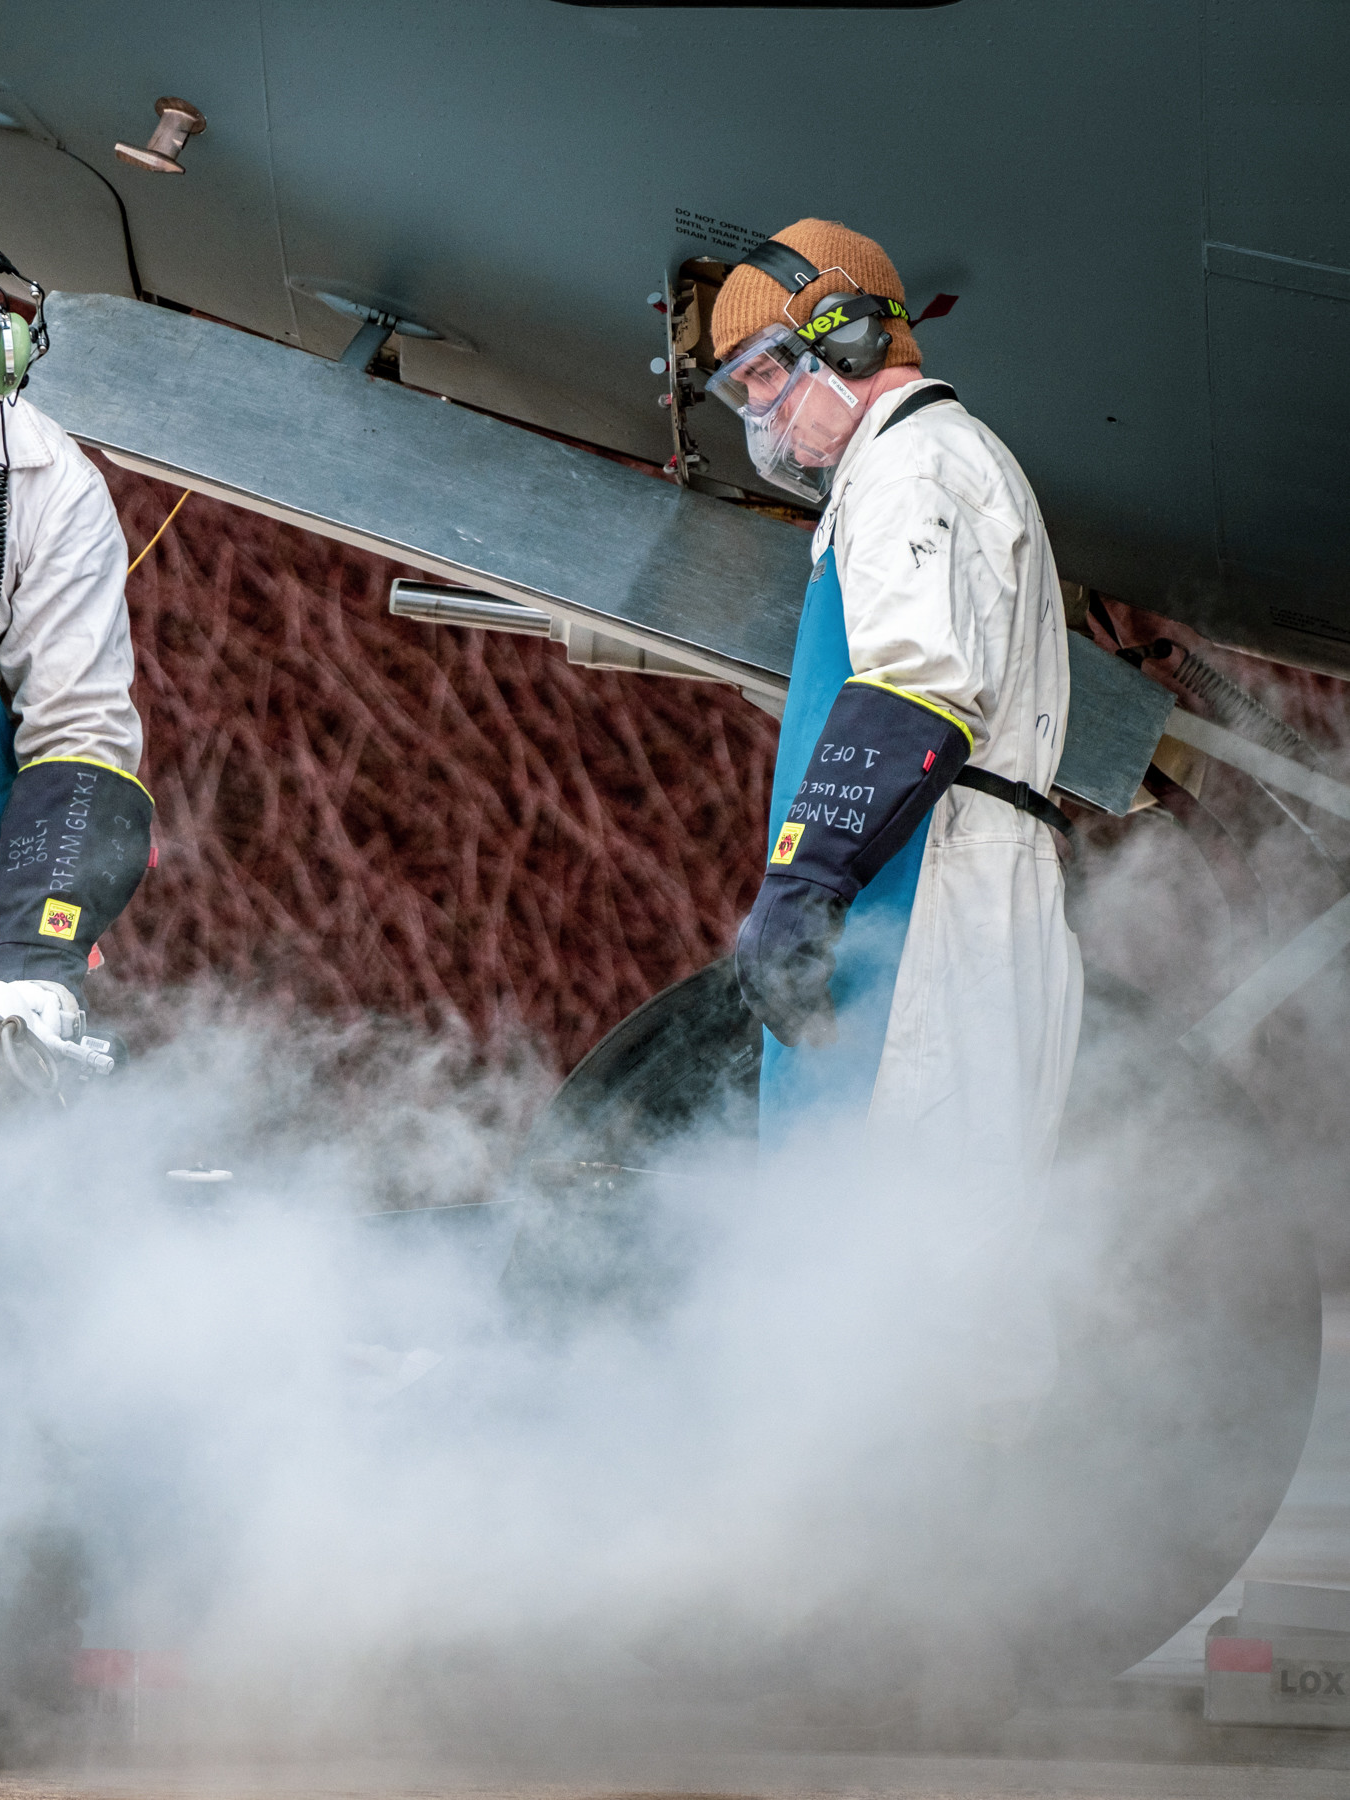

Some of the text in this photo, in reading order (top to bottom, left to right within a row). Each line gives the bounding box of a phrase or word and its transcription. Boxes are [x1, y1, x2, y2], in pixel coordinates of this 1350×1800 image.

[675, 207, 772, 240] DO NOT OPEN DRA
[675, 217, 760, 247] UNTIL DRAIN HO
[675, 226, 707, 241] DRAIN
[712, 237, 737, 250] TANK
[797, 306, 850, 340] vex
[864, 748, 881, 769] 1
[838, 785, 875, 804] LOX
[50, 772, 99, 892] RFAMGLXK1
[791, 801, 866, 834] RFAMGL
[7, 836, 23, 872] LOX
[22, 836, 35, 867] USE
[36, 819, 49, 862] ONLY
[1280, 1669, 1345, 1696] LOX
